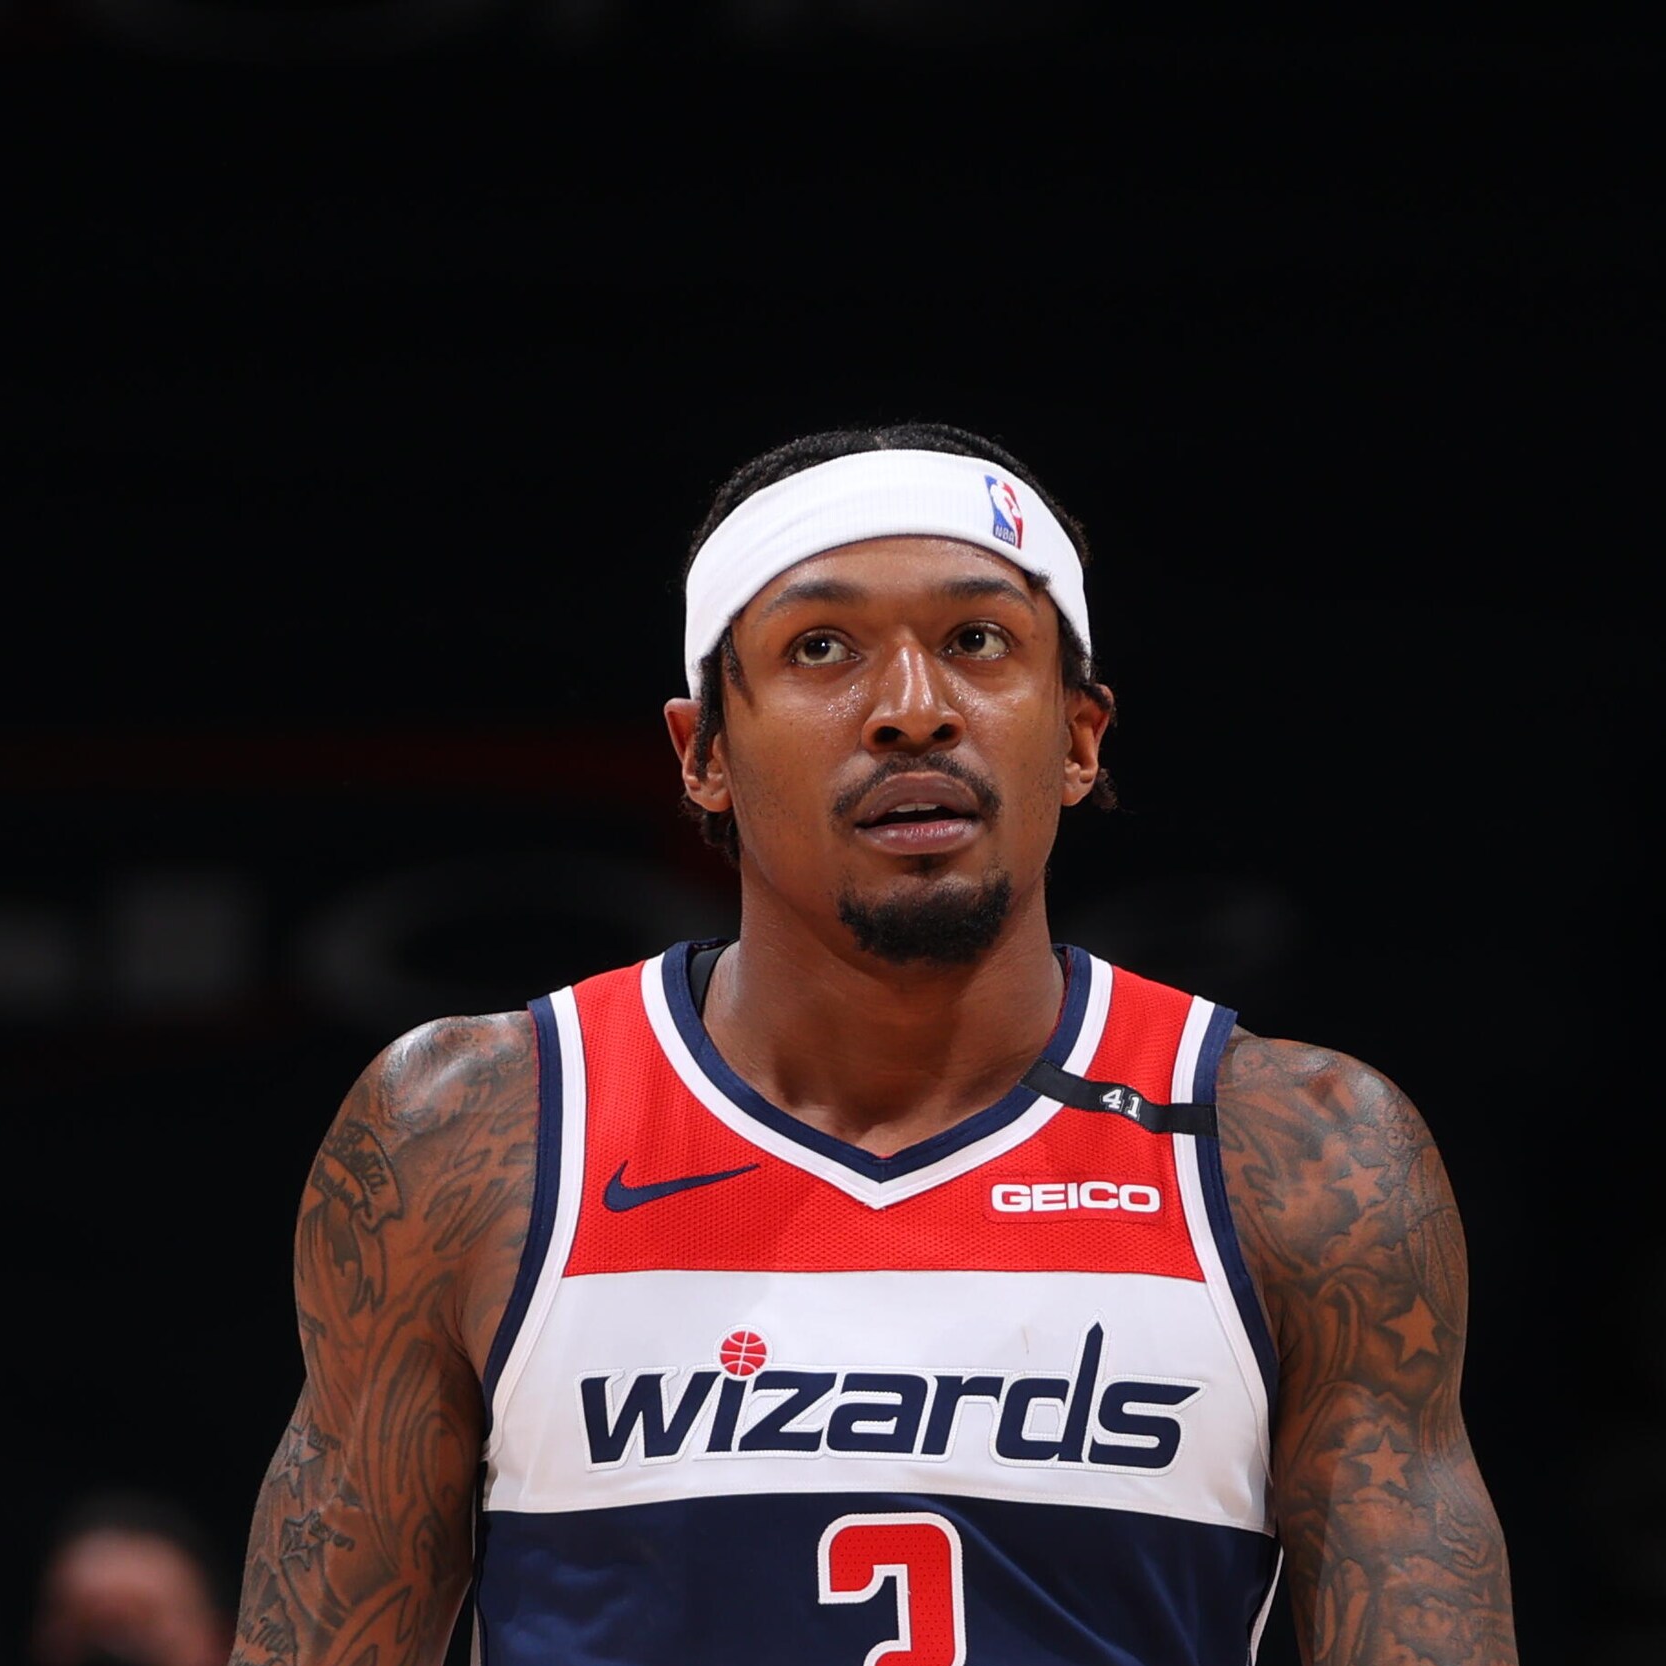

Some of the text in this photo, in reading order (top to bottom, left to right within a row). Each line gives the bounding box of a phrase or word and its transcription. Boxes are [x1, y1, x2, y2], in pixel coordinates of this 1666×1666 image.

[994, 523, 1016, 543] NBA
[1100, 1086, 1141, 1121] 41
[991, 1181, 1161, 1214] GEICO
[578, 1321, 1209, 1476] wizards
